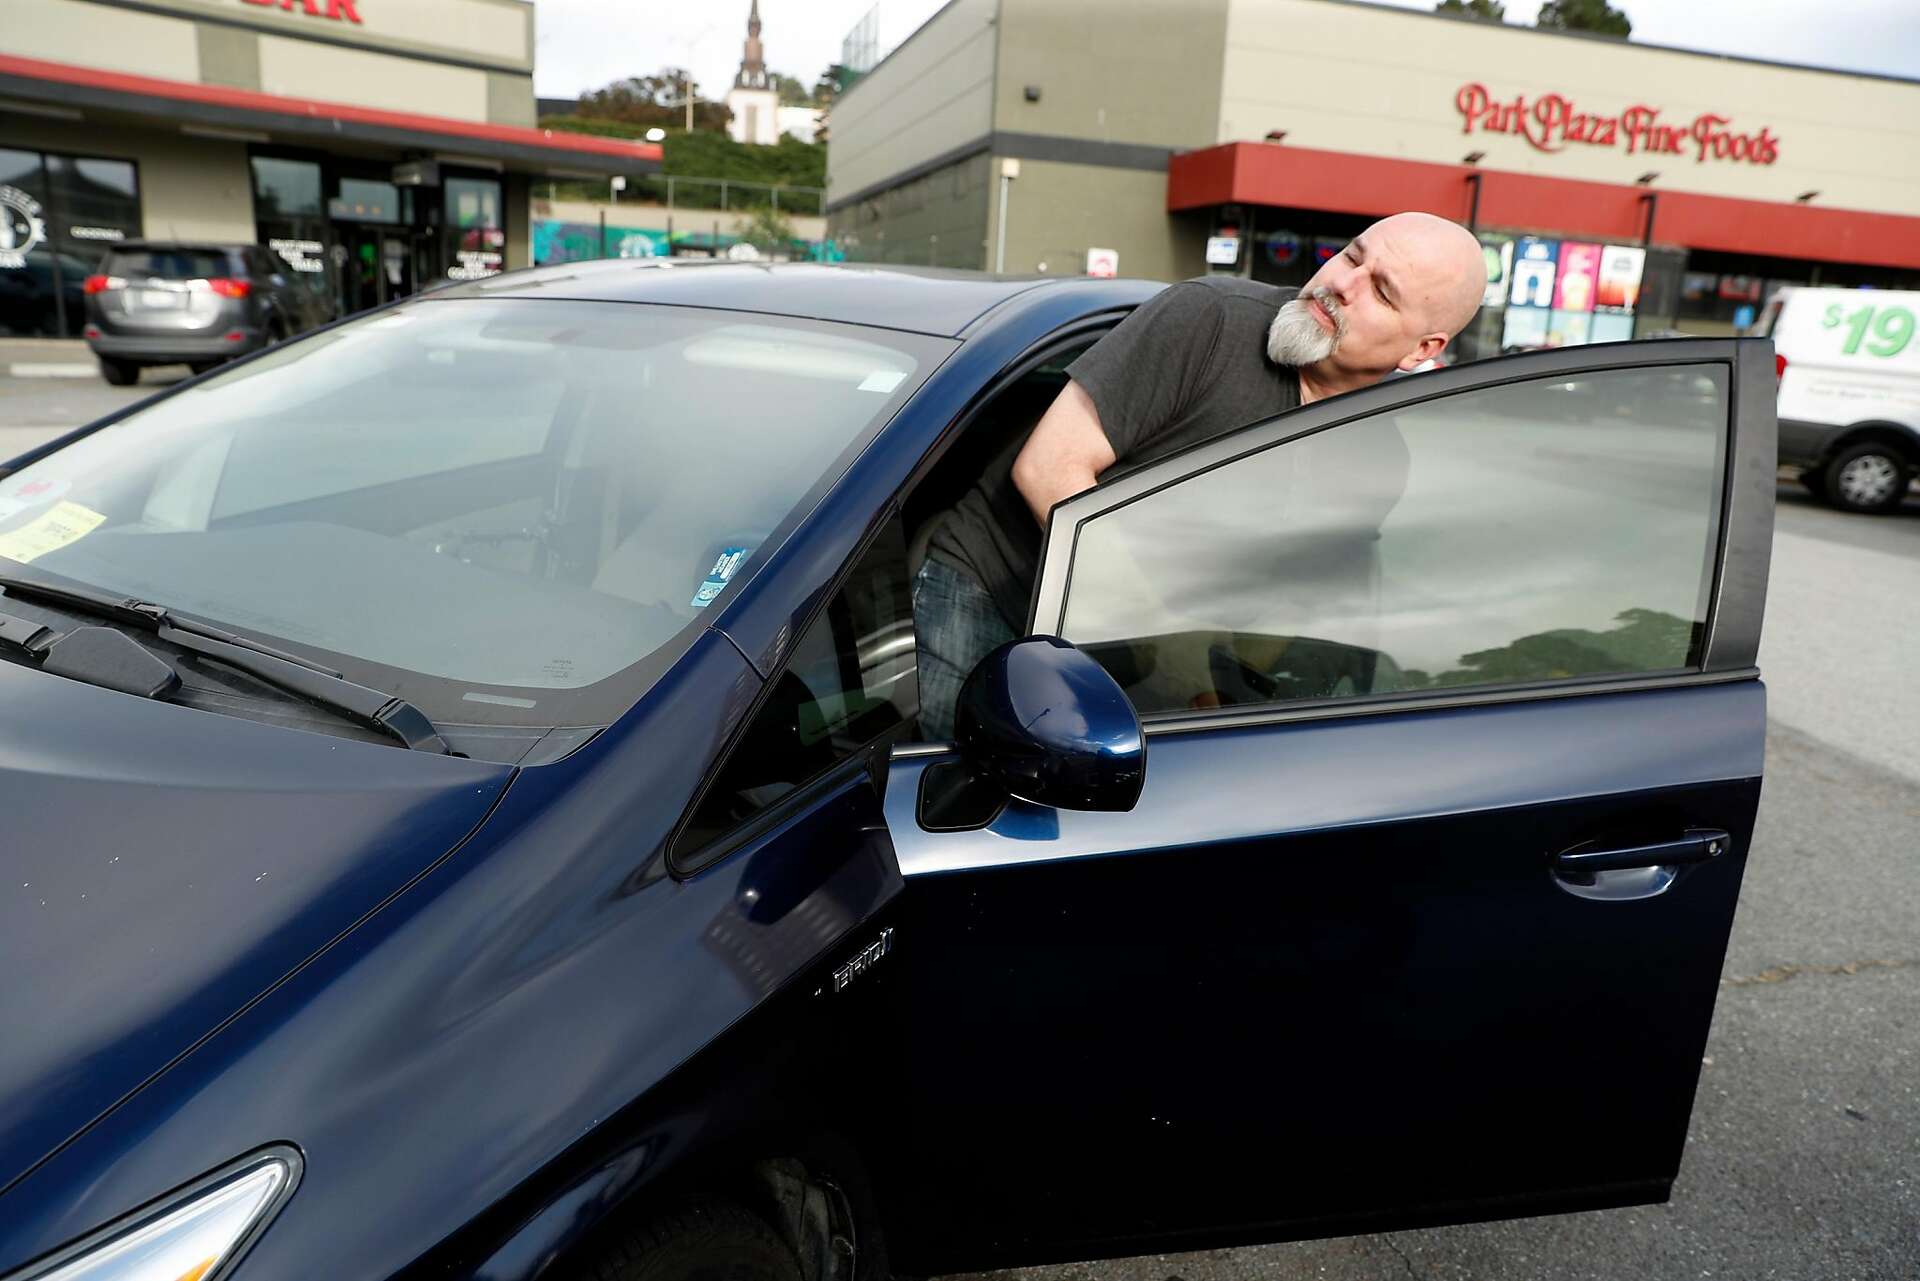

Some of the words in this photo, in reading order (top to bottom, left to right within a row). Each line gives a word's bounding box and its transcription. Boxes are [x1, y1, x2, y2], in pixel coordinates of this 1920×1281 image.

[1455, 82, 1562, 152] Park
[1534, 93, 1619, 146] Plaza
[1622, 105, 1690, 155] Fine
[1692, 114, 1780, 166] Foods
